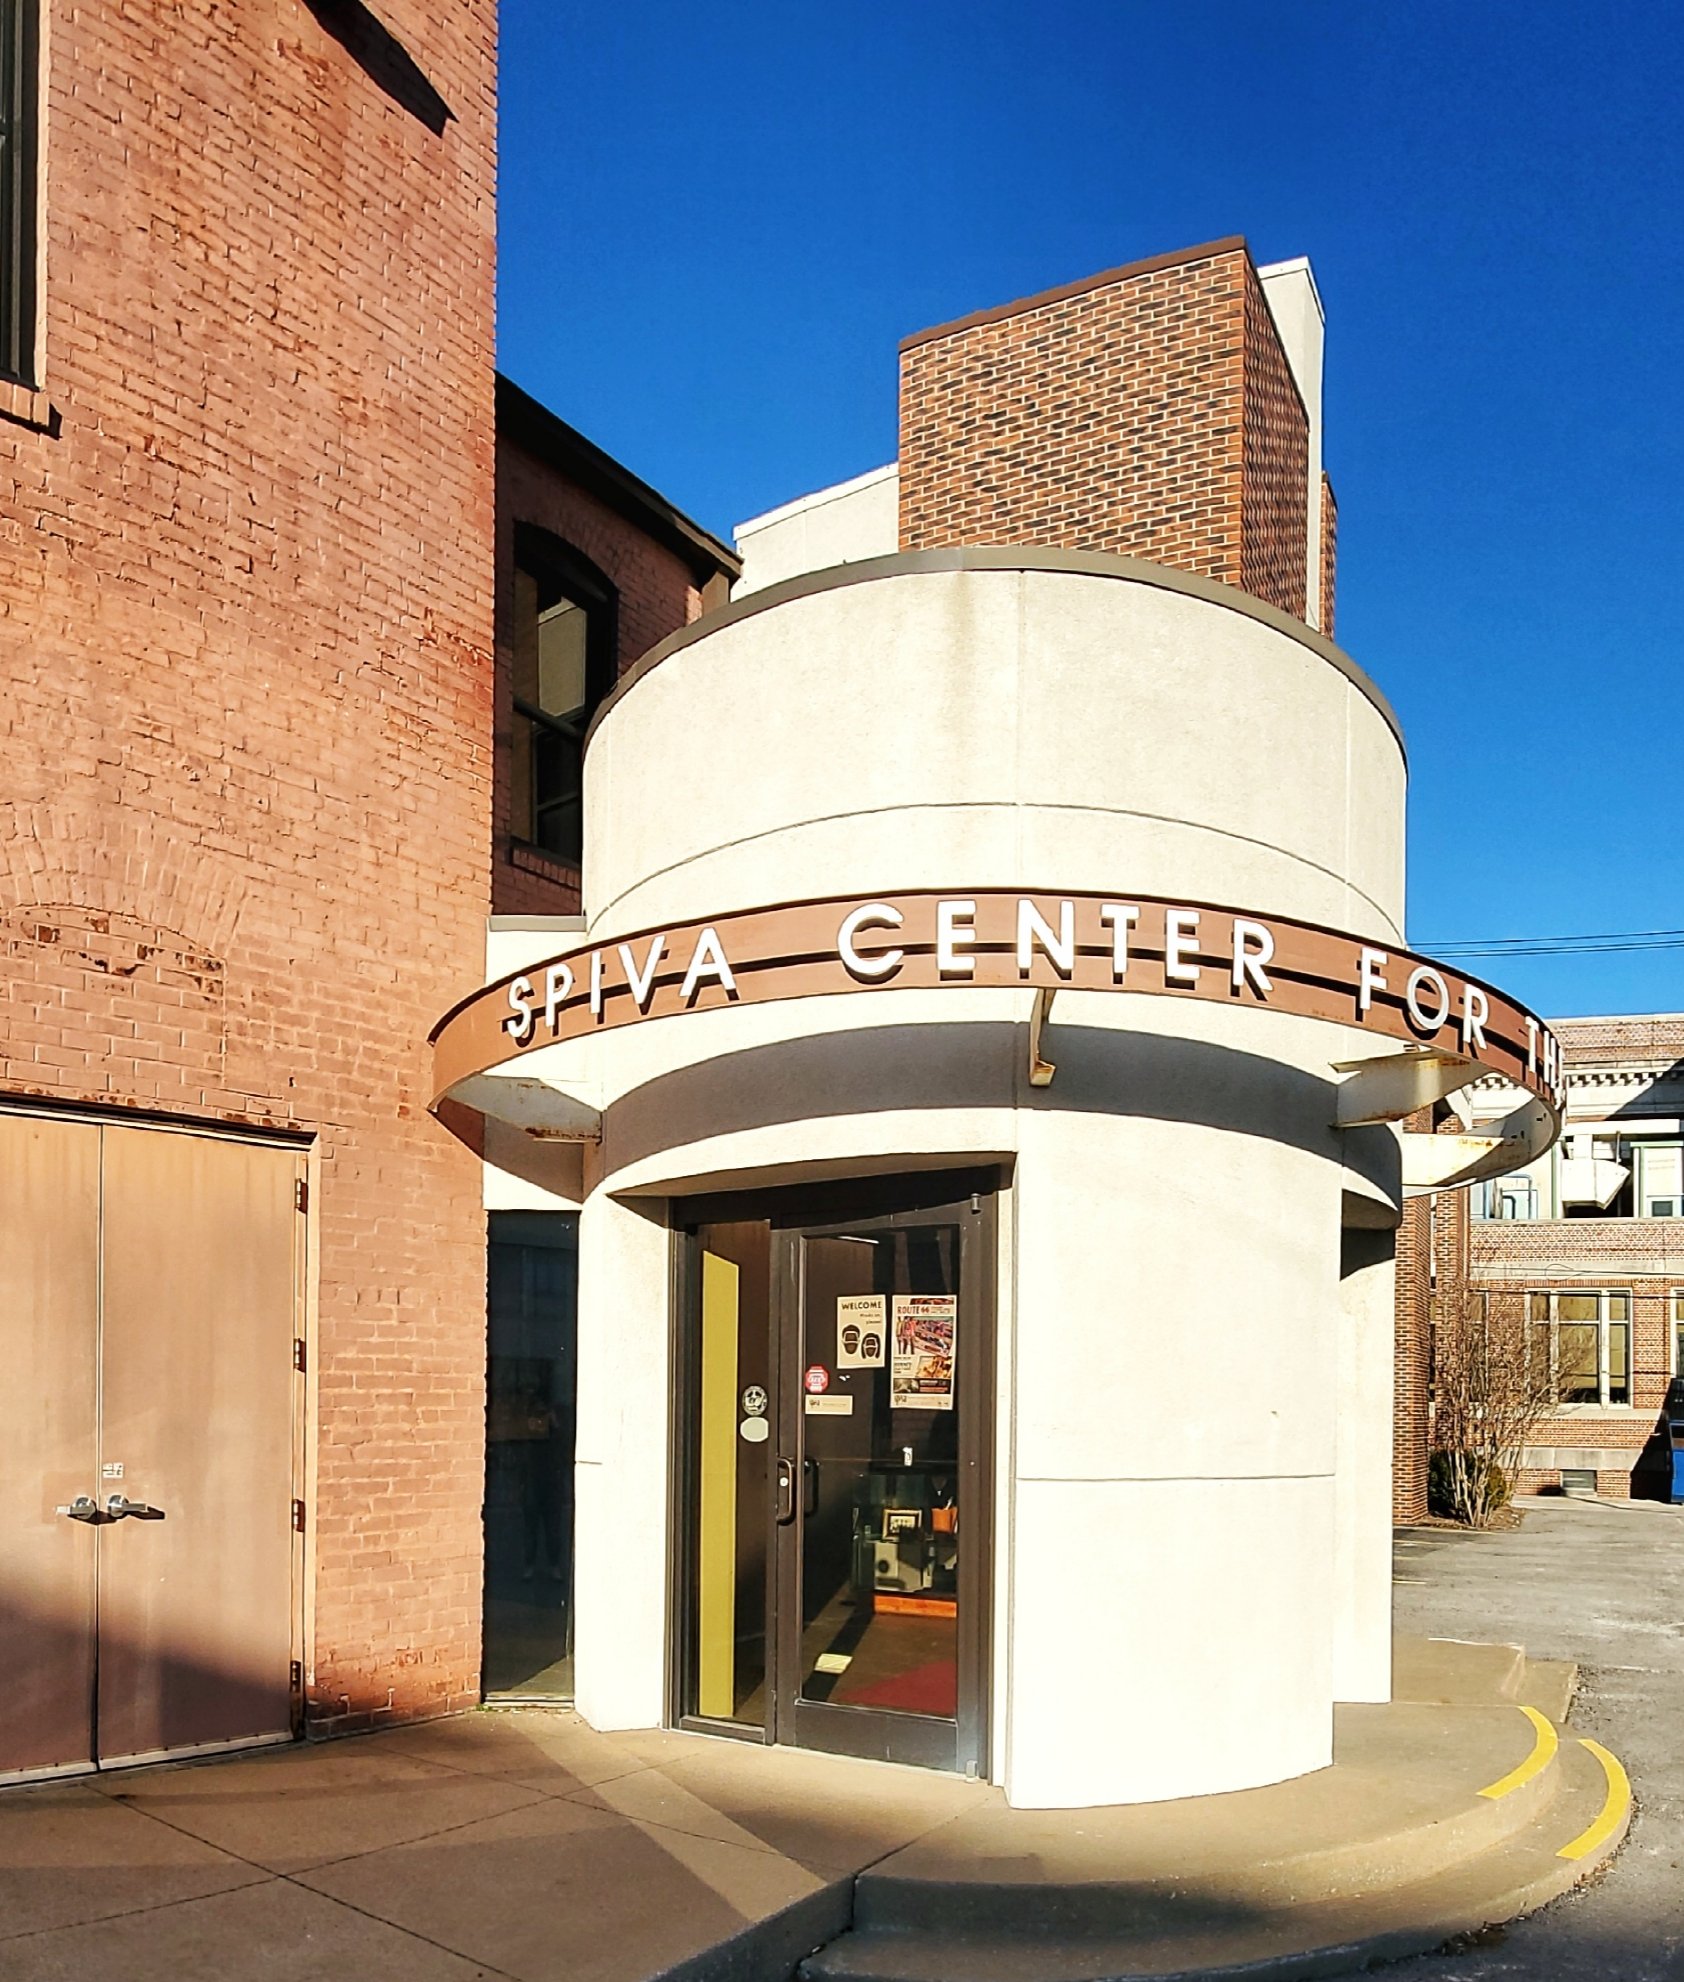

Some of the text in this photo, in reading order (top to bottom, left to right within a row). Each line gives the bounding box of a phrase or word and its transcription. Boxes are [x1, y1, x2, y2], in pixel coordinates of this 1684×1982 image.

[507, 926, 737, 1039] SPIVA
[837, 899, 1274, 992] CENTER
[1359, 947, 1489, 1050] FOR
[841, 1301, 882, 1310] WELCOME
[897, 1306, 920, 1314] ROUTE
